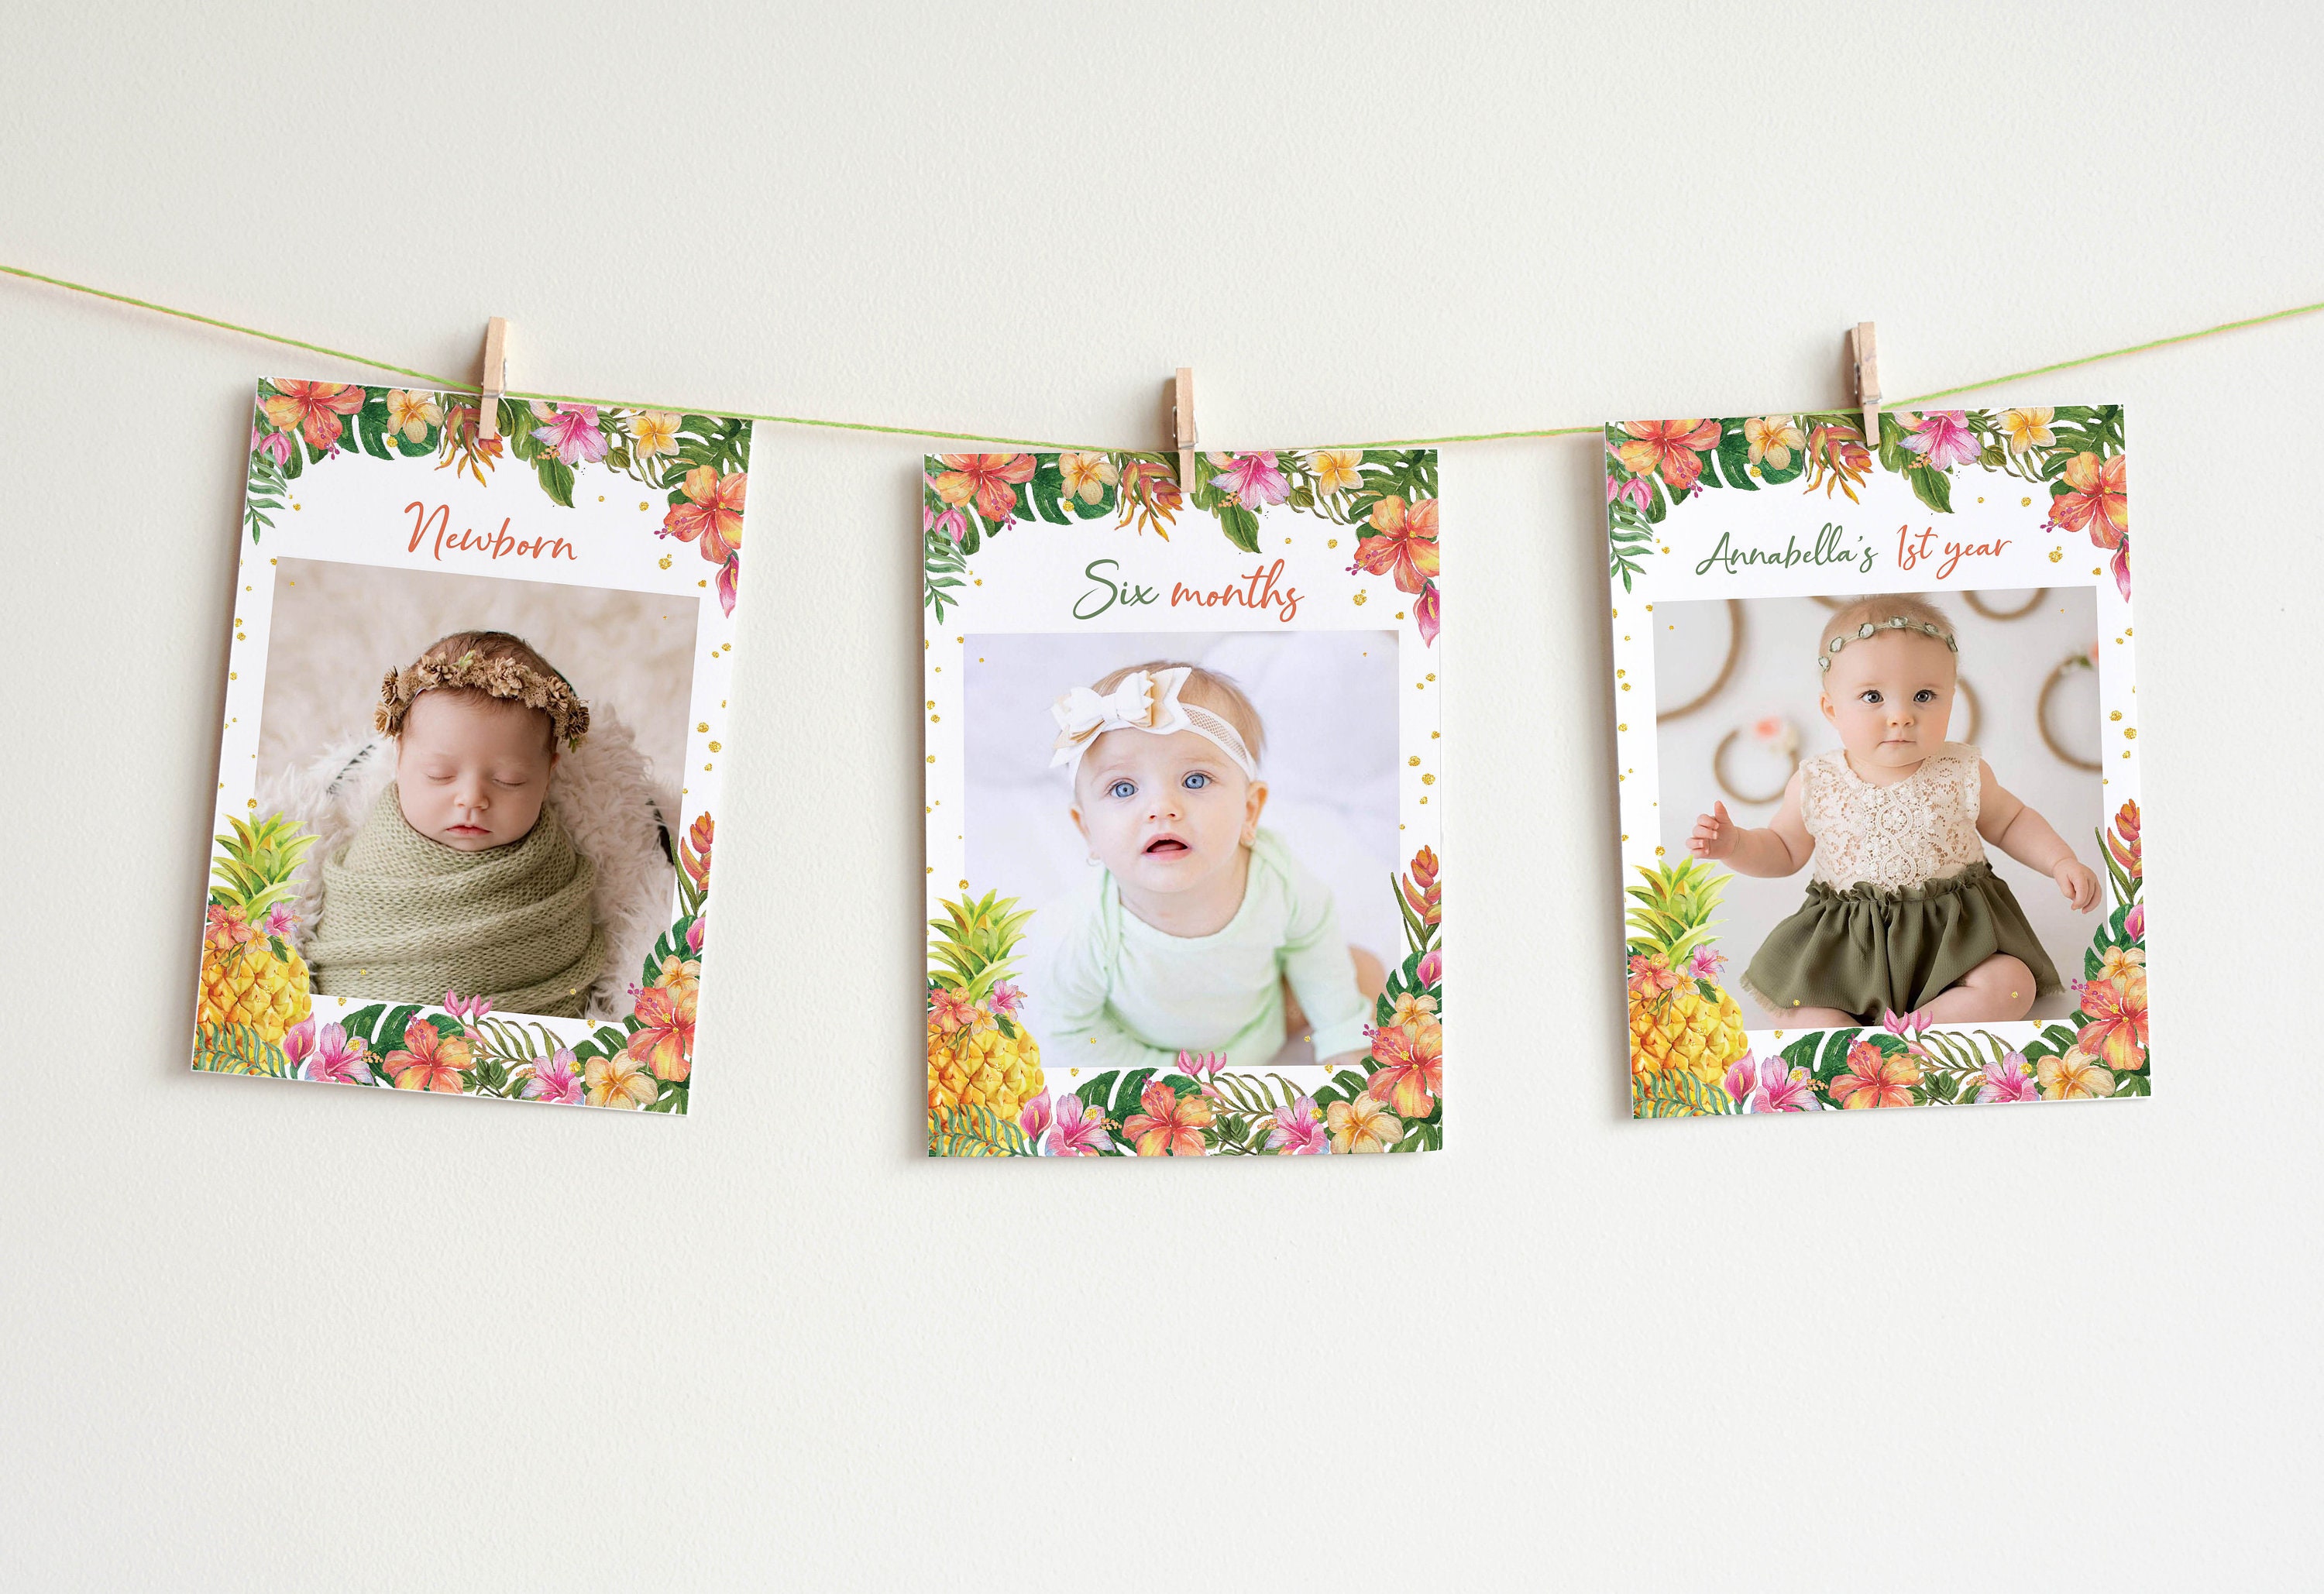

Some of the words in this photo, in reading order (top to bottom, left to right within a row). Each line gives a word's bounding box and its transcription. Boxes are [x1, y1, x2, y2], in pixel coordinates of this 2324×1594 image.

[404, 501, 577, 561] Newborn
[1695, 522, 1879, 575] Annabella's
[1897, 524, 1938, 571] 1st
[1937, 539, 2013, 580] year
[1072, 559, 1160, 620] Six
[1171, 558, 1305, 623] months
